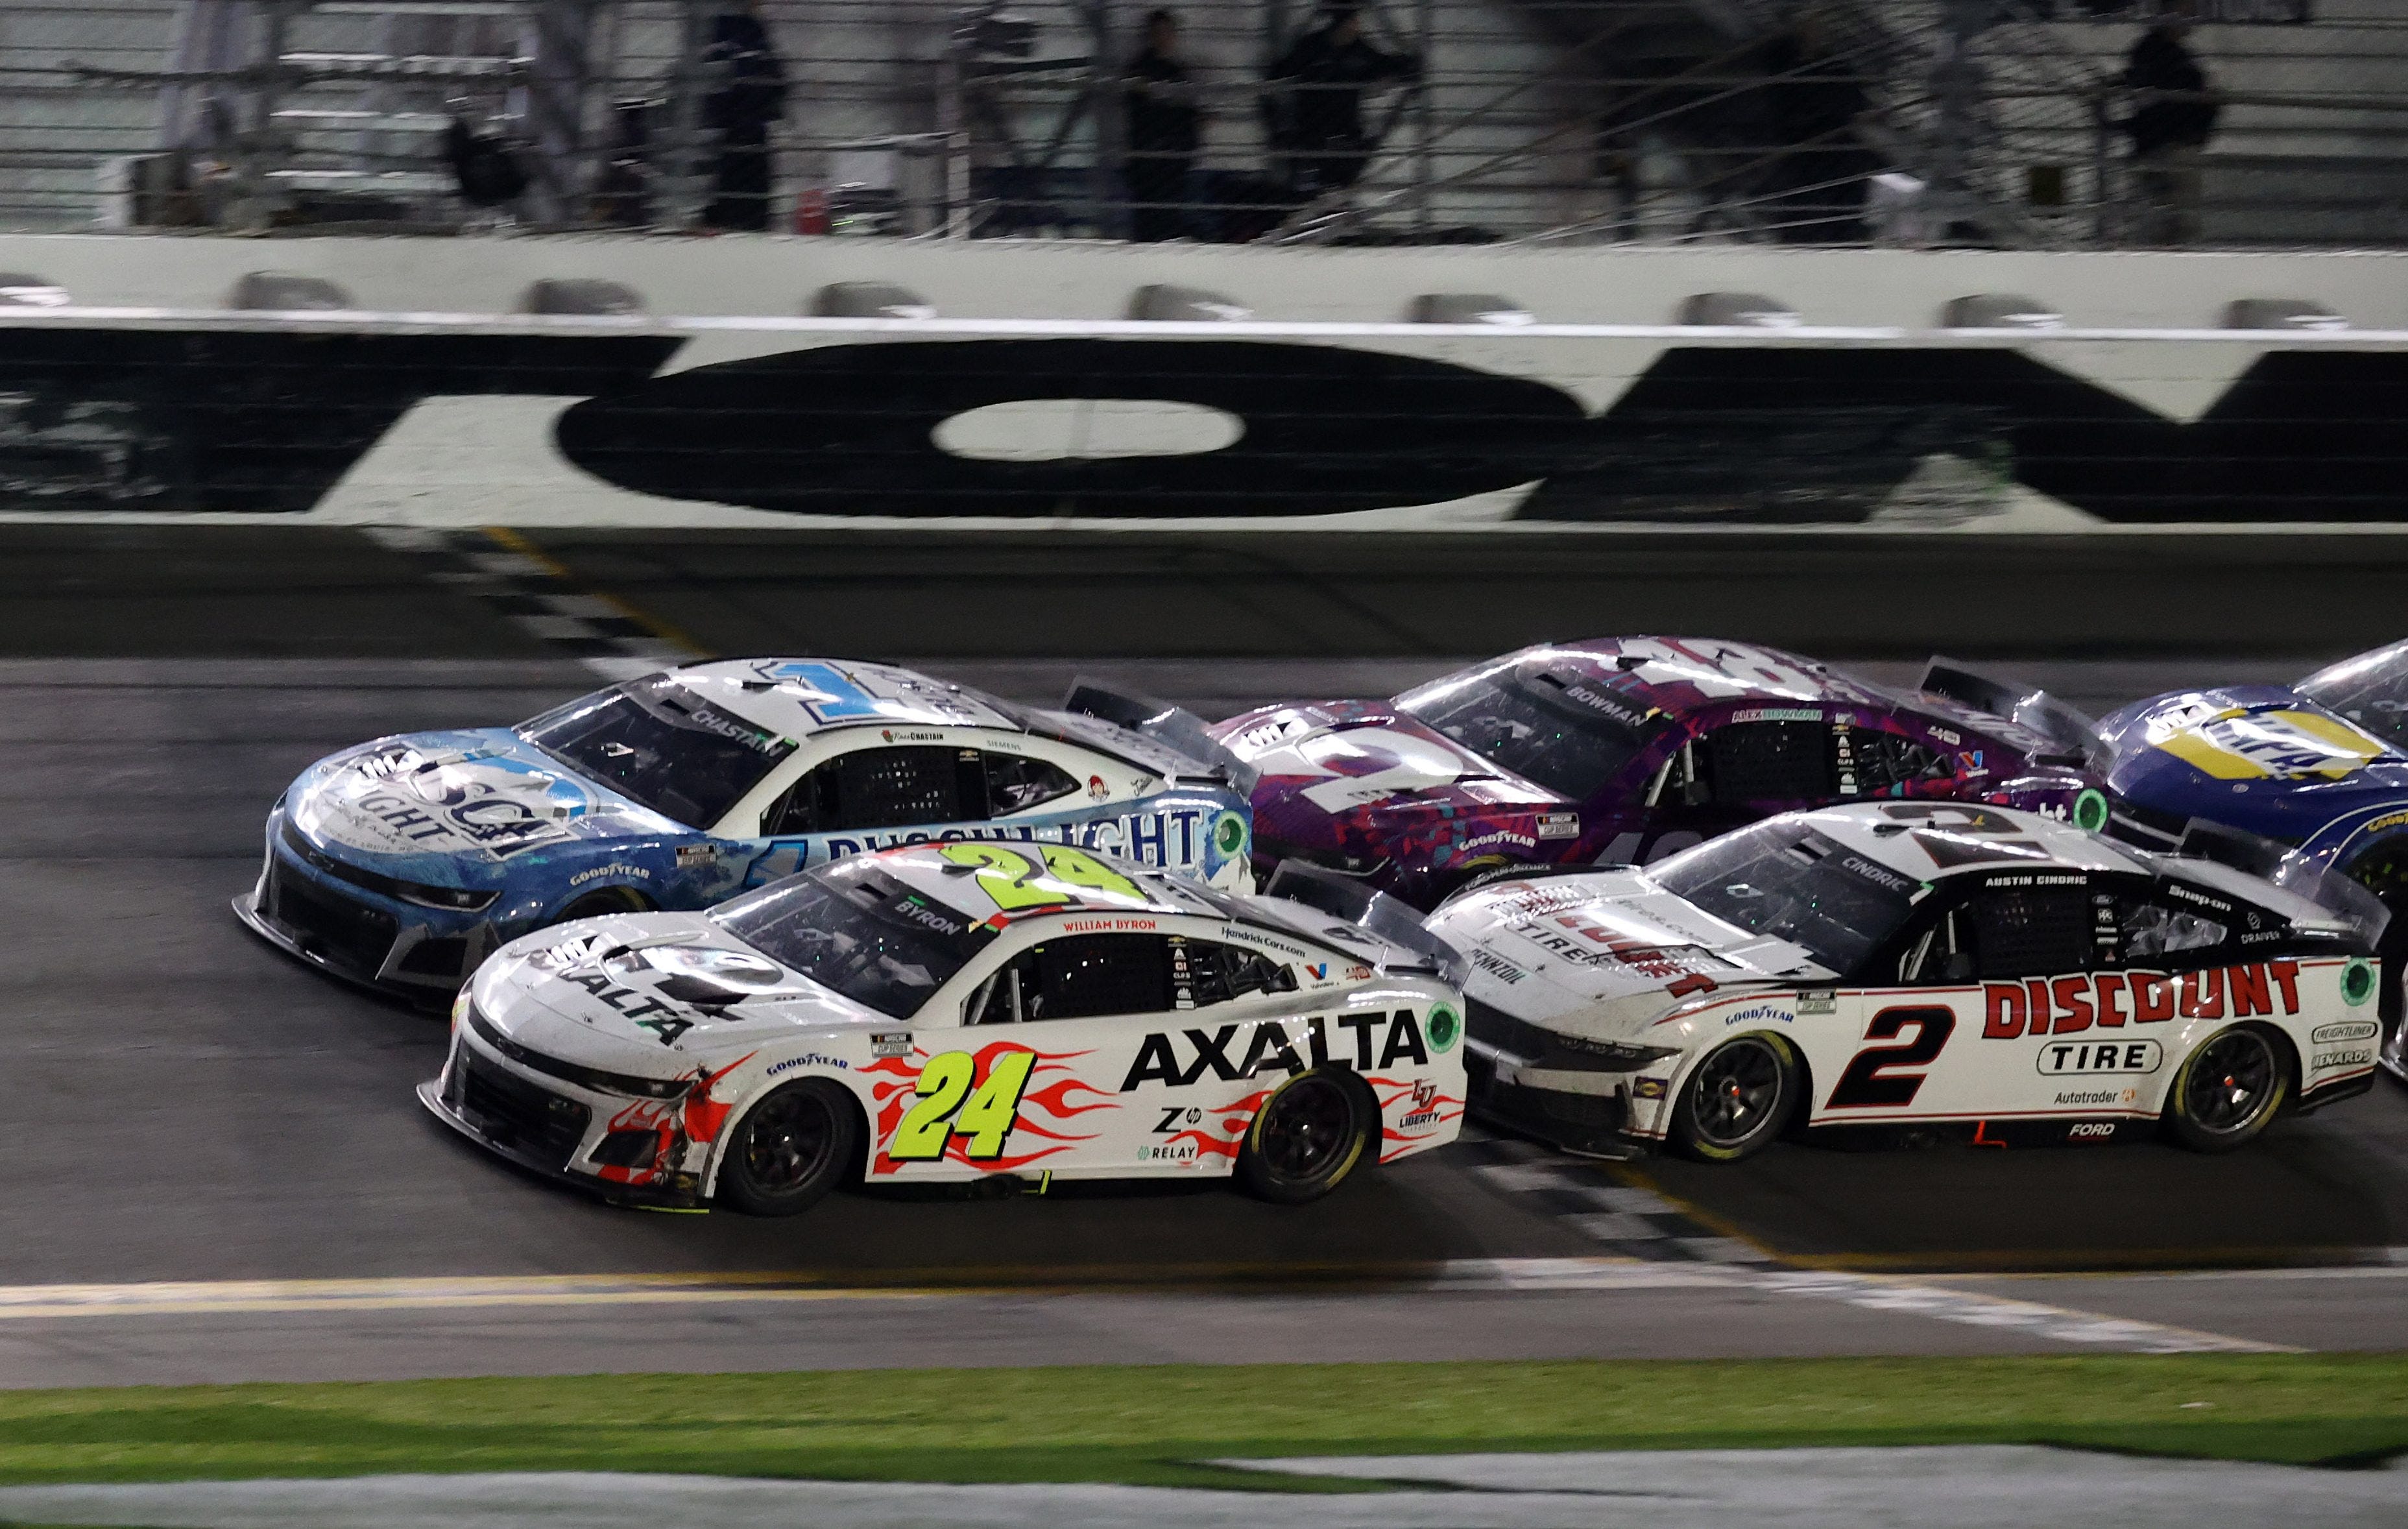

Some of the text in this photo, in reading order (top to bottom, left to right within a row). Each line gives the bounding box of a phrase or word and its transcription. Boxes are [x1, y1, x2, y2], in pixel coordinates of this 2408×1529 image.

[1566, 685, 1648, 727] BOWMAN
[910, 732, 944, 741] CHASTAIN
[1459, 830, 1536, 851] GOODYEAR
[570, 863, 650, 886] GOODYEAR
[939, 844, 1161, 911] 24
[1842, 857, 1909, 891] CINDRIC
[1985, 875, 2088, 887] AUSTIN CINDRIC
[2169, 884, 2232, 912] Snap-on
[895, 902, 961, 936] BYRON
[1063, 919, 1157, 932] WILLIAM BYRON
[1519, 922, 1589, 961] TIRE
[1981, 959, 2300, 1039] DISCOUNT
[1725, 1005, 1794, 1026] GOODYEAR
[1118, 1008, 1429, 1093] AXALTA
[1824, 1004, 1956, 1111] 2
[2052, 1044, 2147, 1070] TIRE
[767, 1053, 849, 1076] GOODYEAR
[888, 1050, 1038, 1162] 24
[2054, 1090, 2119, 1104] Autotrader
[1399, 1111, 1441, 1129] LIBERTY
[2069, 1124, 2115, 1136] FORD
[1152, 1146, 1196, 1159] RELAY
